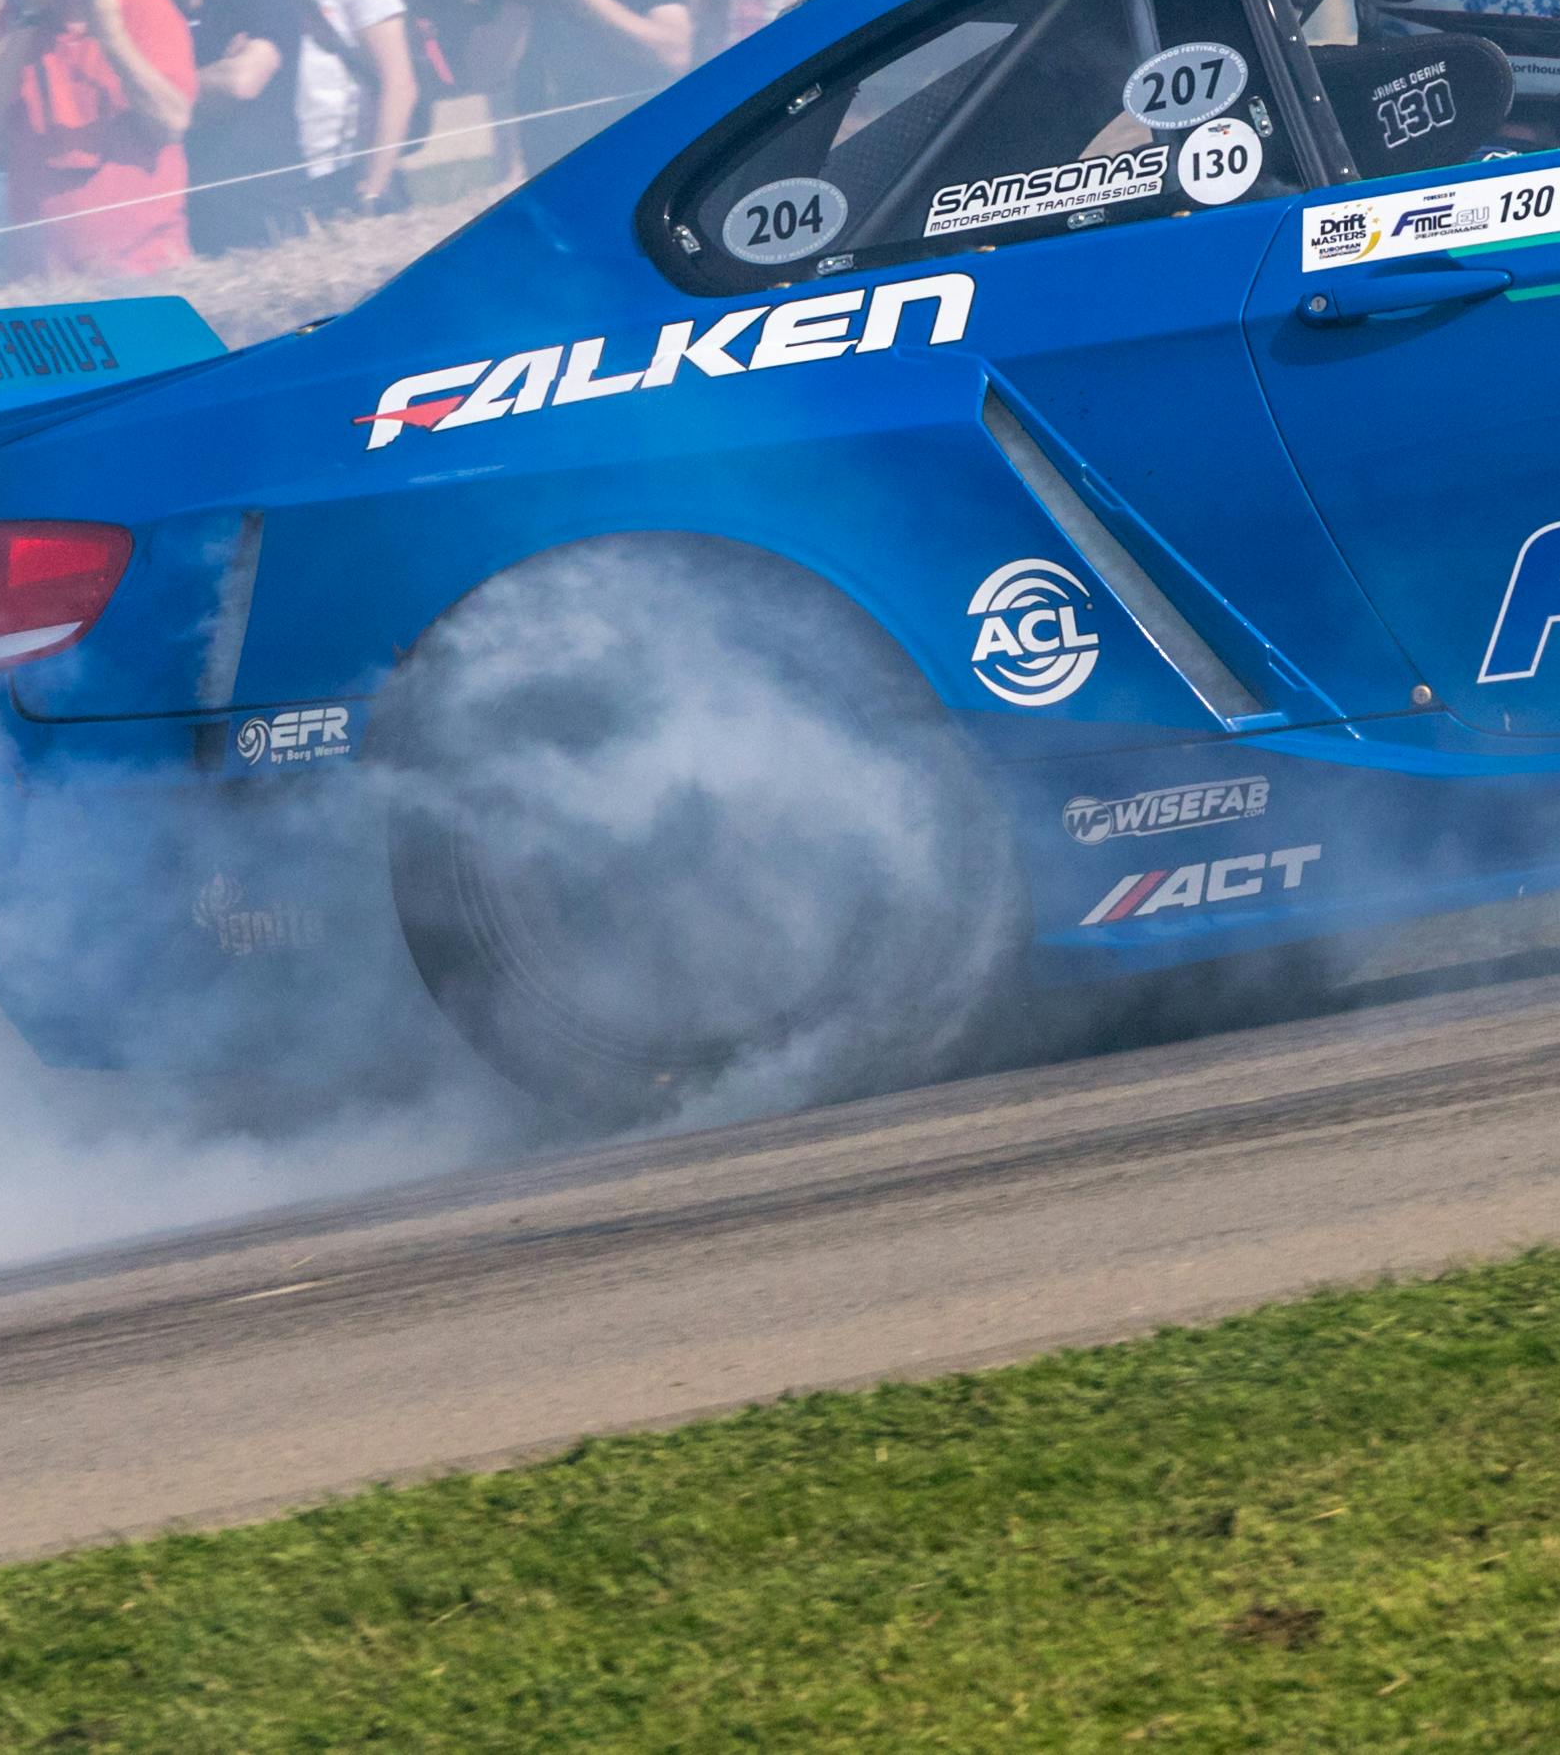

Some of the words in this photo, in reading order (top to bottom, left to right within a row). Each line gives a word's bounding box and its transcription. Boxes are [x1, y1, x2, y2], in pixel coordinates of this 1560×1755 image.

[1134, 49, 1180, 80] GOODWOOD
[1181, 45, 1217, 54] FESTIVAL
[1219, 48, 1231, 56] OF
[1229, 51, 1246, 75] SPEED
[1371, 77, 1407, 101] JAMES
[1408, 61, 1447, 85] DEANE
[1142, 58, 1225, 113] 207
[1190, 92, 1238, 125] MASTERCARD
[1376, 78, 1457, 148] 130
[932, 149, 1165, 217] SAMSONAS
[1192, 145, 1248, 181] 130
[746, 194, 823, 246] 204
[929, 205, 1031, 233] MOTORSPORT
[1036, 181, 1159, 213] TRANSMISSIONS
[1320, 213, 1367, 236] Drift
[1500, 185, 1555, 223] 130
[1310, 229, 1367, 247] MASTERS
[1319, 242, 1361, 255] EUROPEAN
[1414, 223, 1489, 240] PERFORMANCE
[353, 271, 976, 450] FALKEN
[970, 605, 1099, 662] ACL
[270, 706, 350, 749] EFR
[271, 752, 283, 764] by
[286, 748, 311, 763] Borg
[314, 744, 351, 758] Warner
[1114, 782, 1270, 832] WISEFAB
[1134, 844, 1322, 916] ACT
